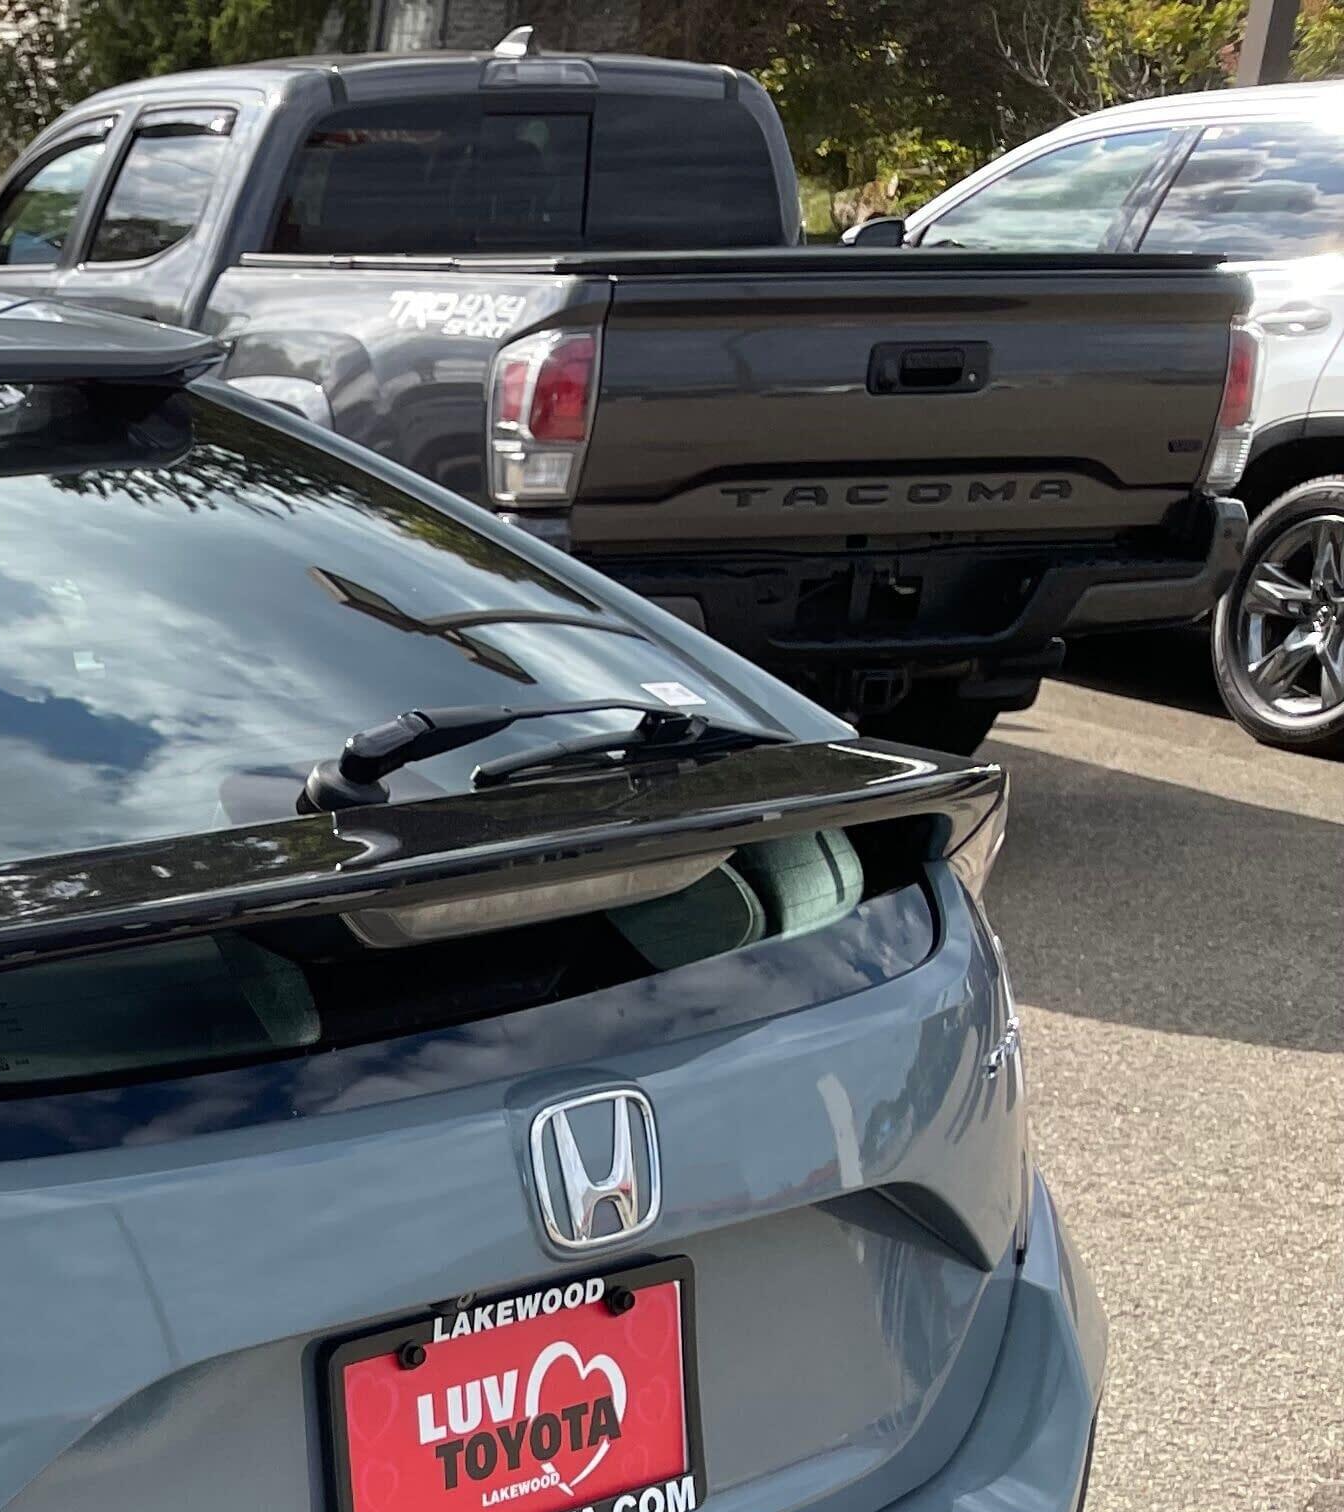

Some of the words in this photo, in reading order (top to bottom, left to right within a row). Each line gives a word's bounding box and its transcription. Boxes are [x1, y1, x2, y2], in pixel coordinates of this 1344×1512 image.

[388, 290, 460, 330] TRD
[719, 479, 1073, 508] TACOMA
[432, 1277, 605, 1344] LAKEWOOD
[416, 1369, 519, 1445] LUV
[435, 1395, 623, 1491] TOYOTA
[481, 1471, 560, 1508] LAKEWOOD
